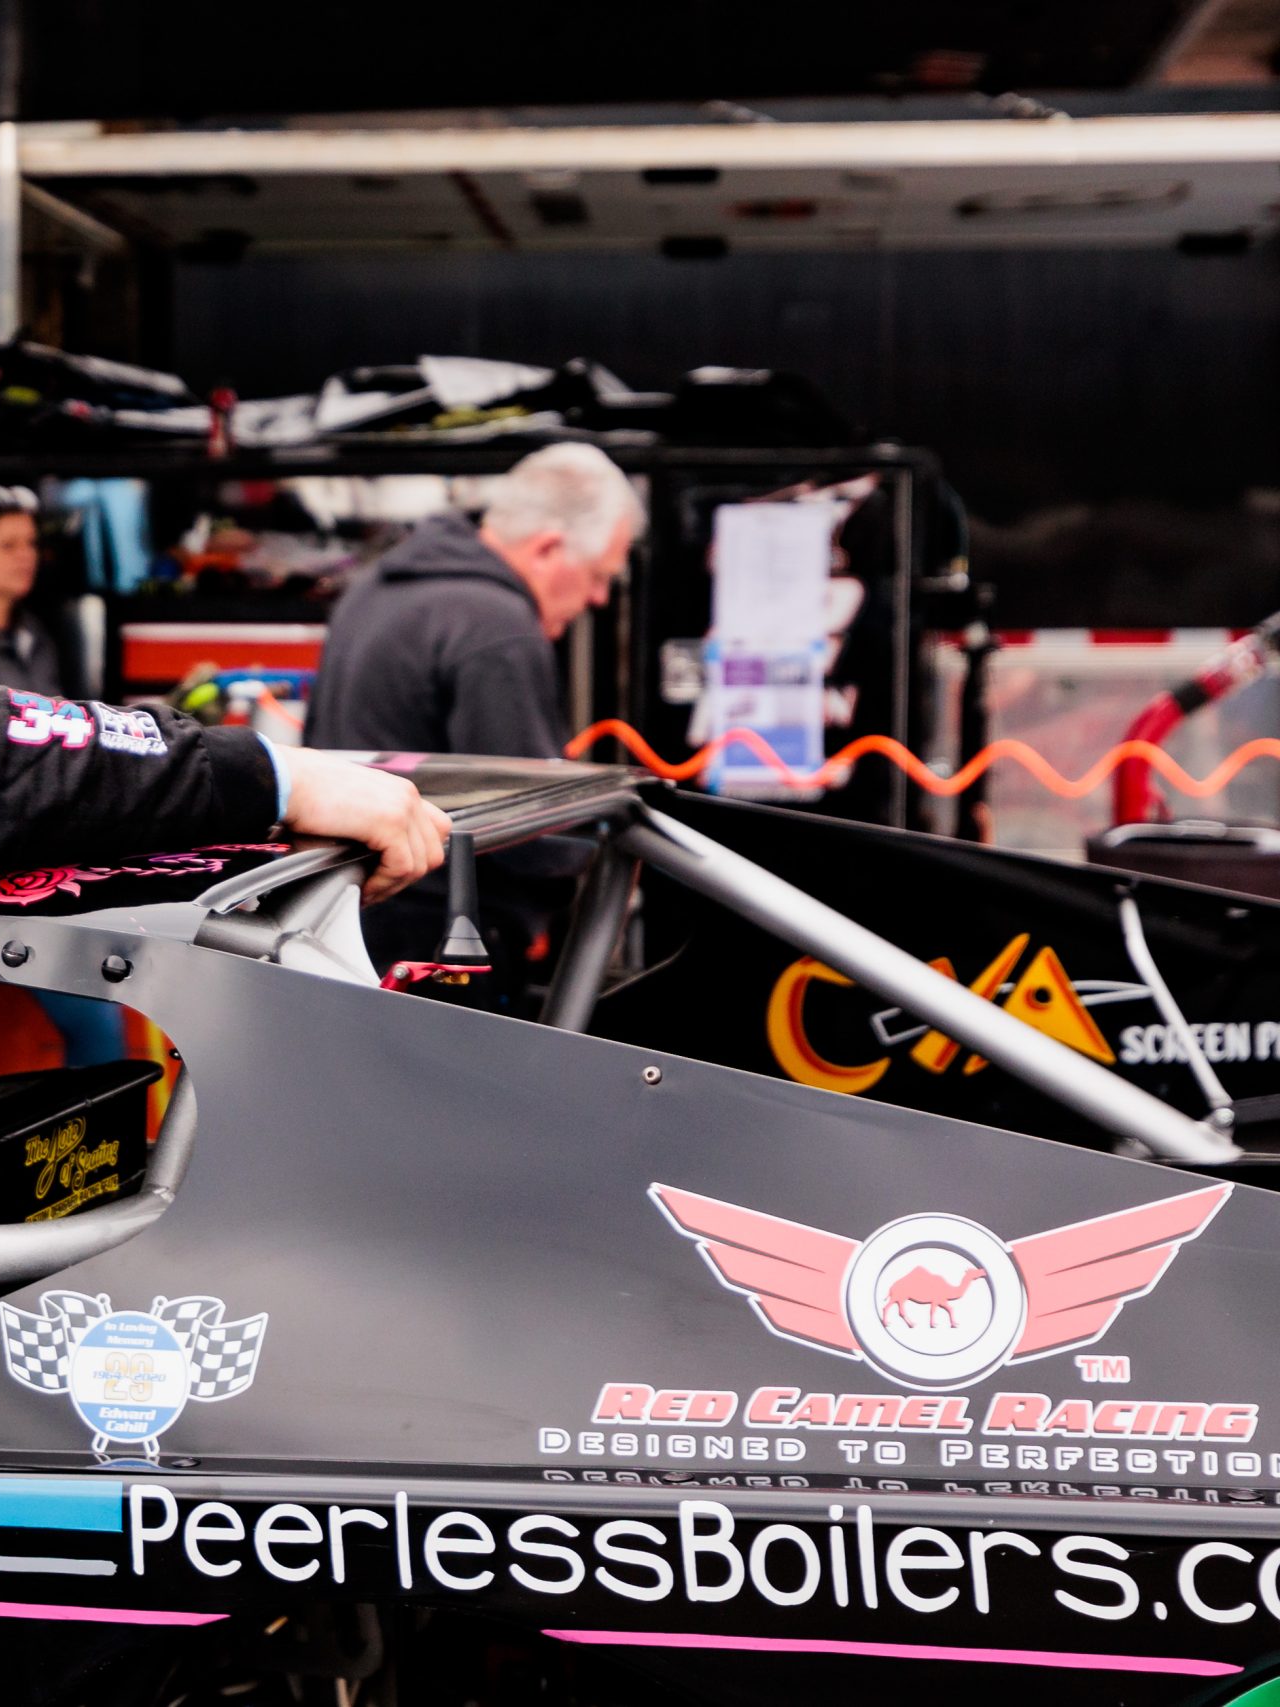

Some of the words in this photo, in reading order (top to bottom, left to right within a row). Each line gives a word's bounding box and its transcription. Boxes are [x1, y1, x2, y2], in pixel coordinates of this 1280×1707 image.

[7, 688, 95, 749] 34
[24, 1134, 49, 1166] The
[104, 1322, 117, 1332] In
[119, 1322, 158, 1335] Loving
[1075, 1355, 1131, 1383] TM
[99, 1406, 157, 1421] Edward
[105, 1420, 149, 1433] Cahill
[538, 1427, 807, 1462] DESIGNED
[838, 1439, 906, 1465] TO
